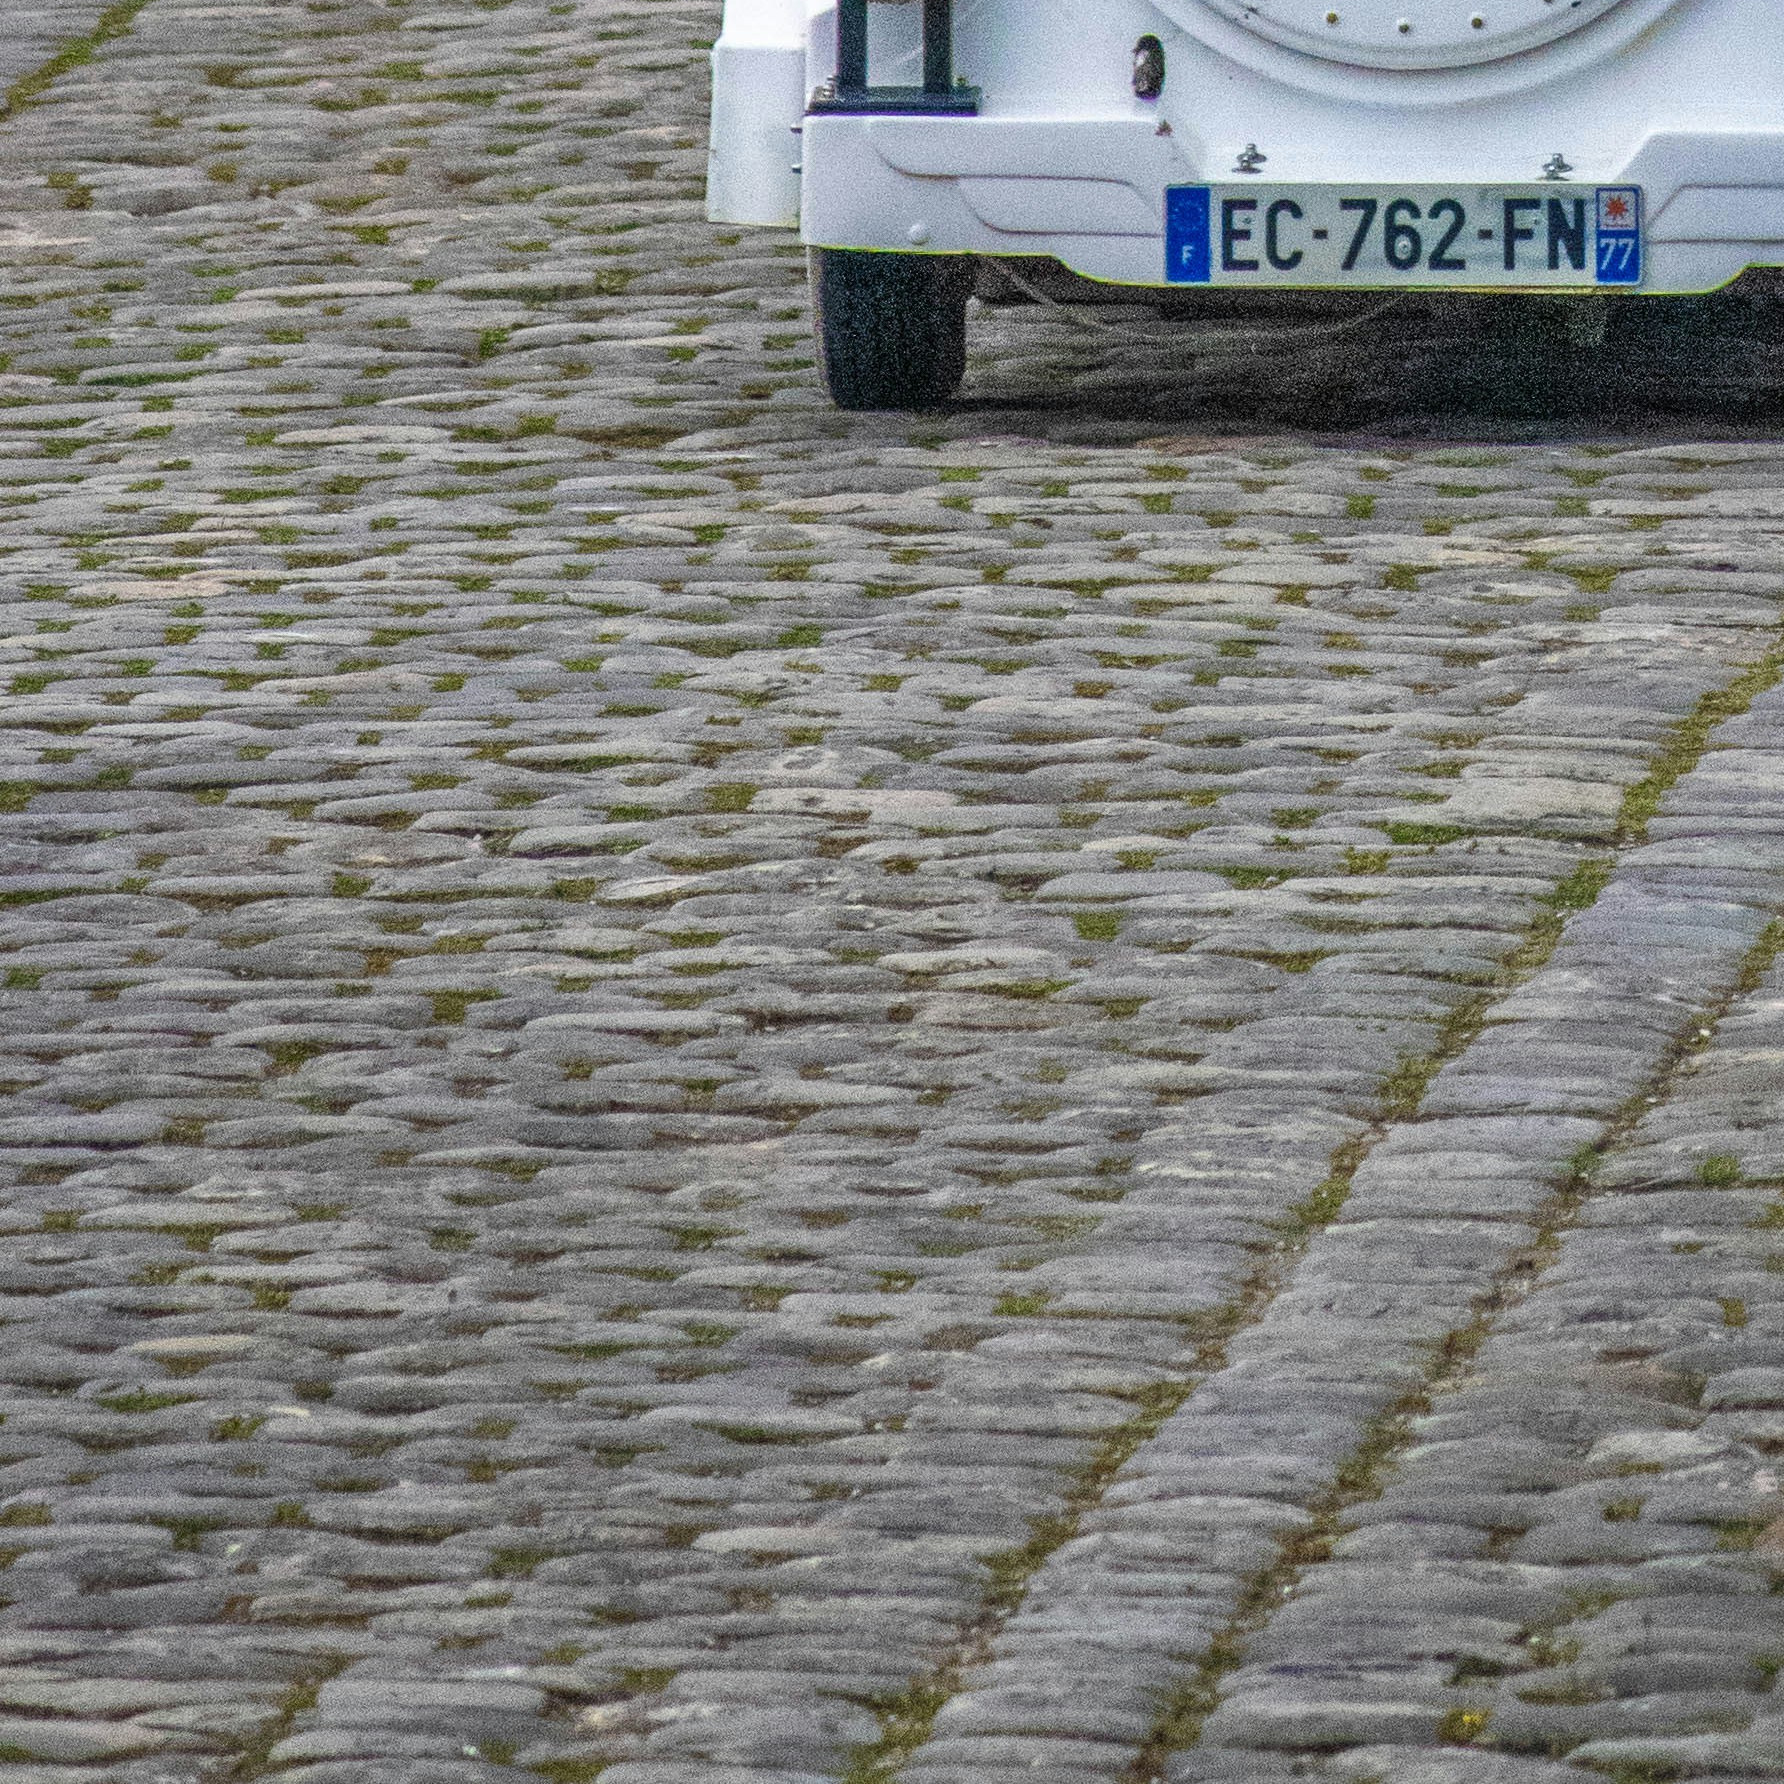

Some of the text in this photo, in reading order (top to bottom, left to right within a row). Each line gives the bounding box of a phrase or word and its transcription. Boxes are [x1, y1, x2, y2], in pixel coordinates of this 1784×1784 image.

[1222, 196, 1588, 271] EC-762-FN
[1182, 245, 1194, 266] F
[1600, 237, 1635, 271] 77
